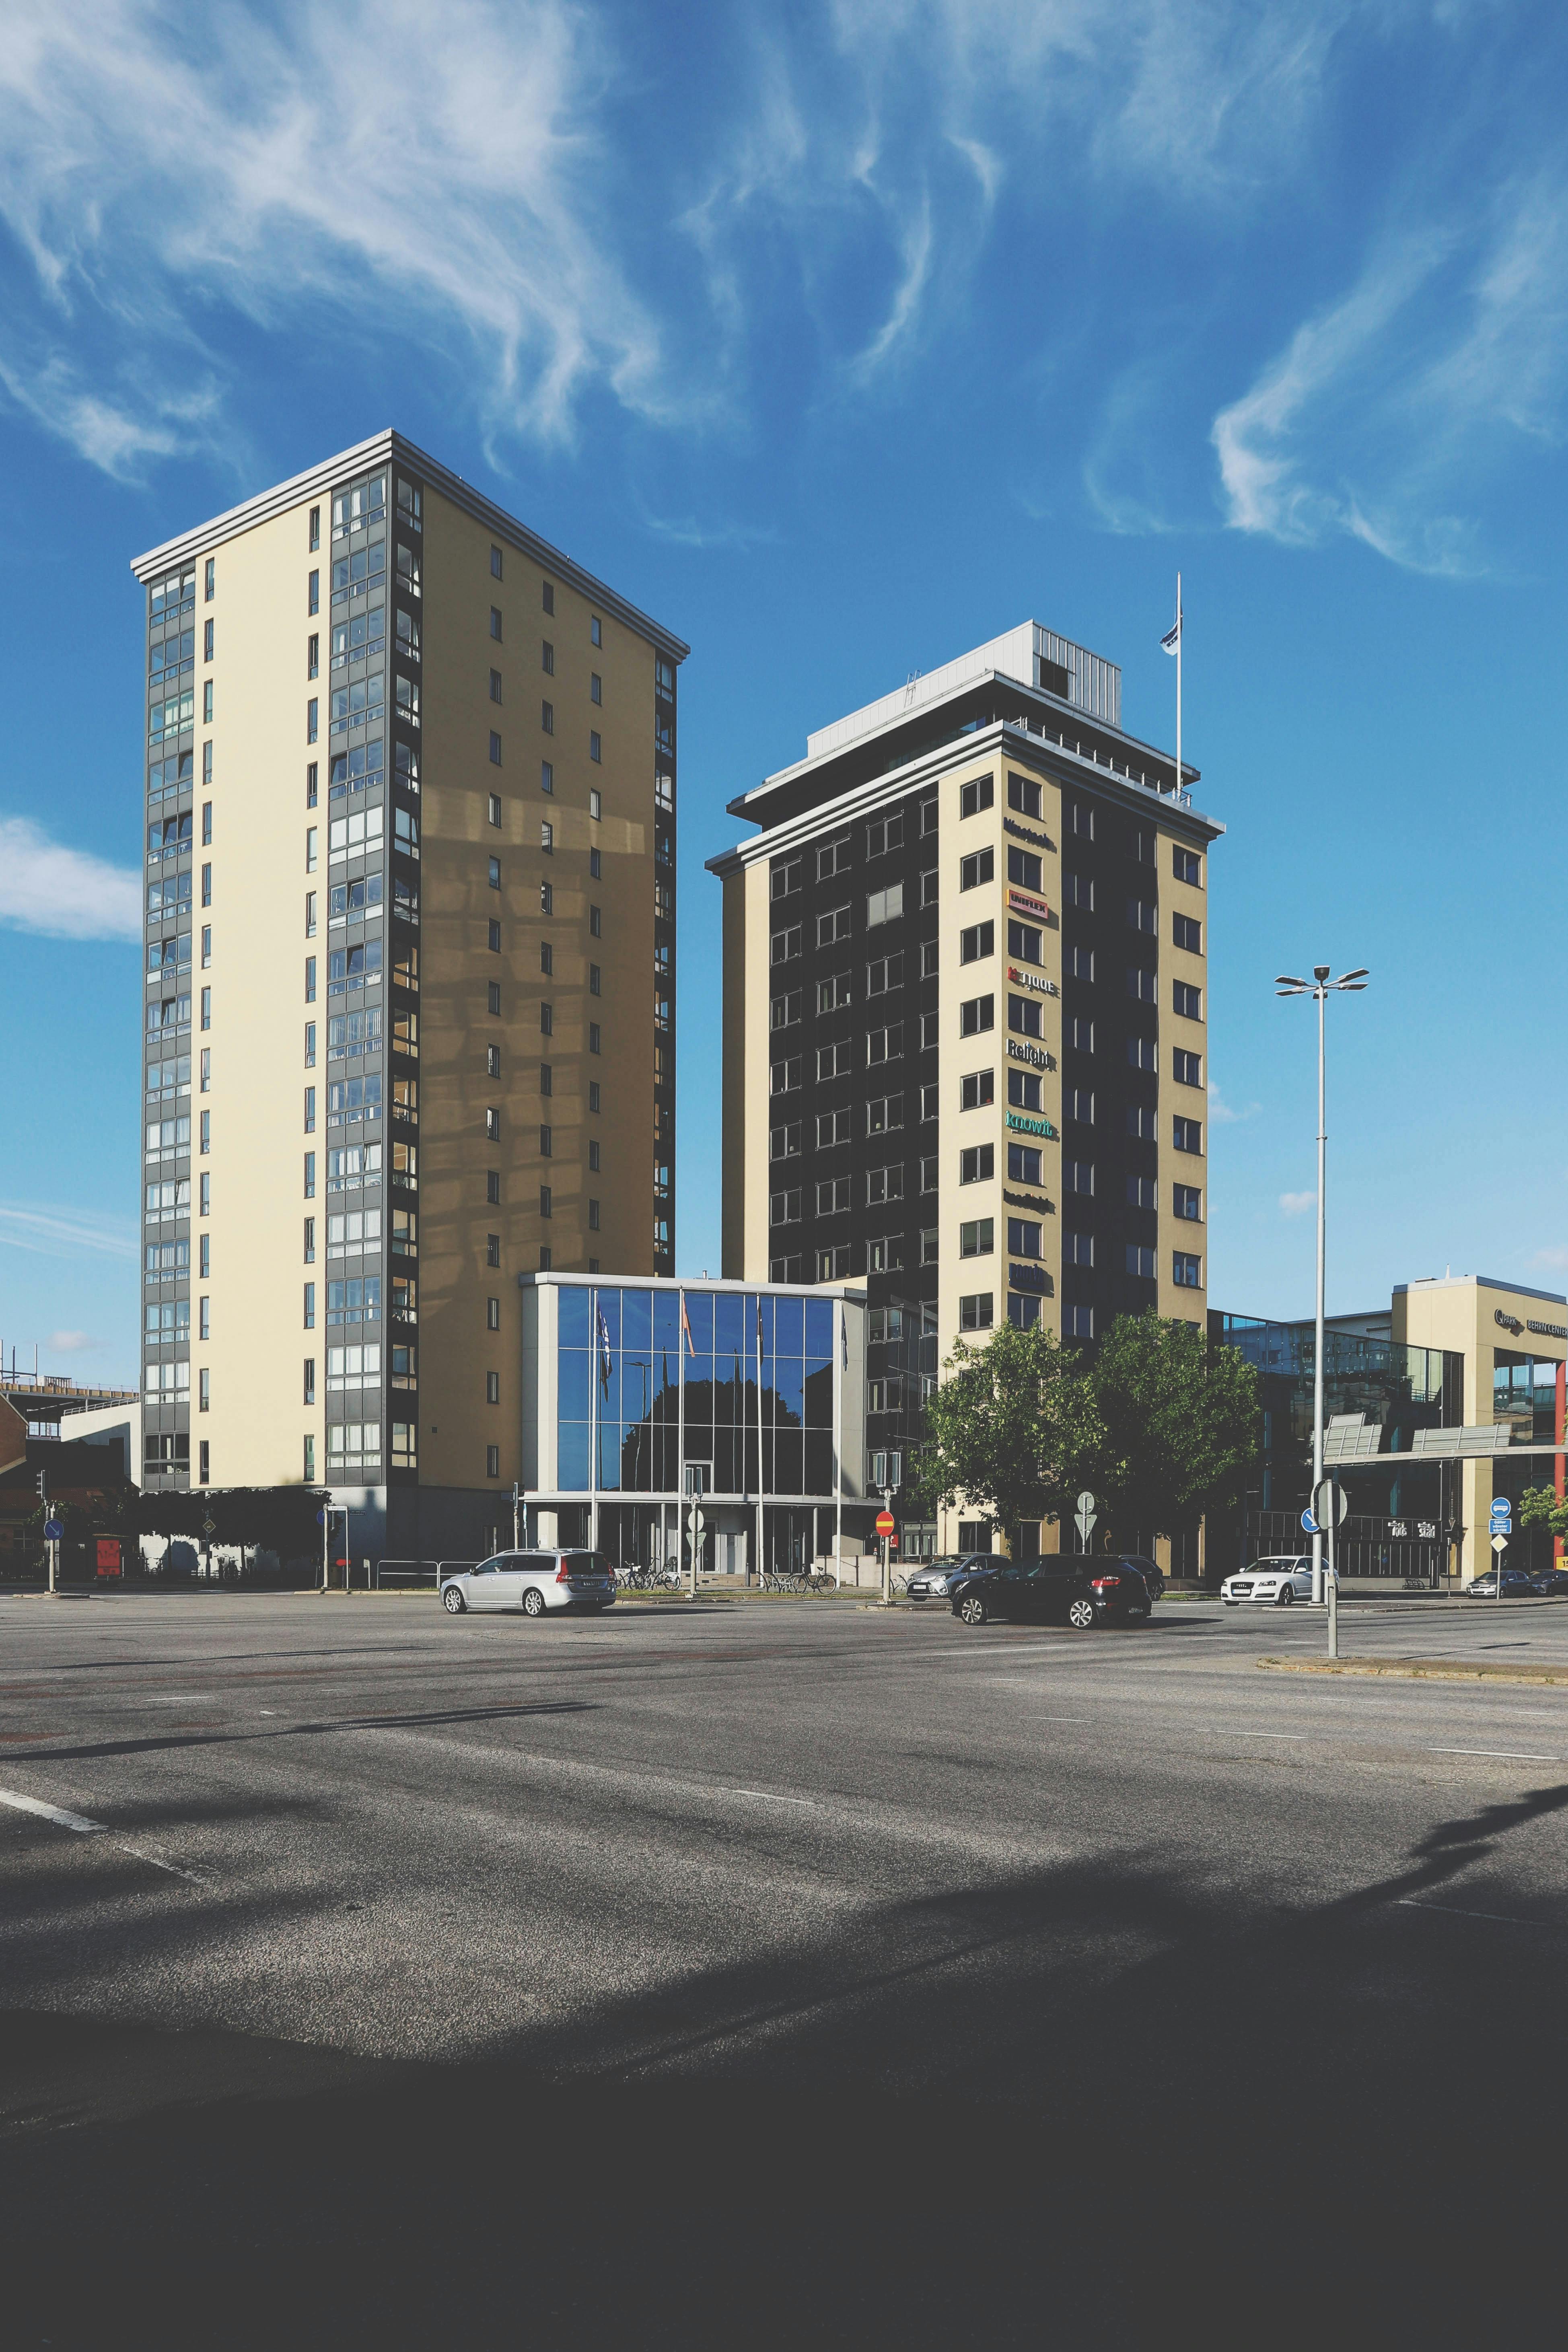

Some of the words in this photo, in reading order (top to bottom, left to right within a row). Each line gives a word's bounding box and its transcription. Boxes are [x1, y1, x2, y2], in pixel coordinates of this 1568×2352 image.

[1010, 893, 1046, 913] UNIFLEX
[1021, 970, 1054, 993] TIQQE
[1005, 1110, 1053, 1136] knowit
[1528, 1319, 1547, 1332] BEHRN
